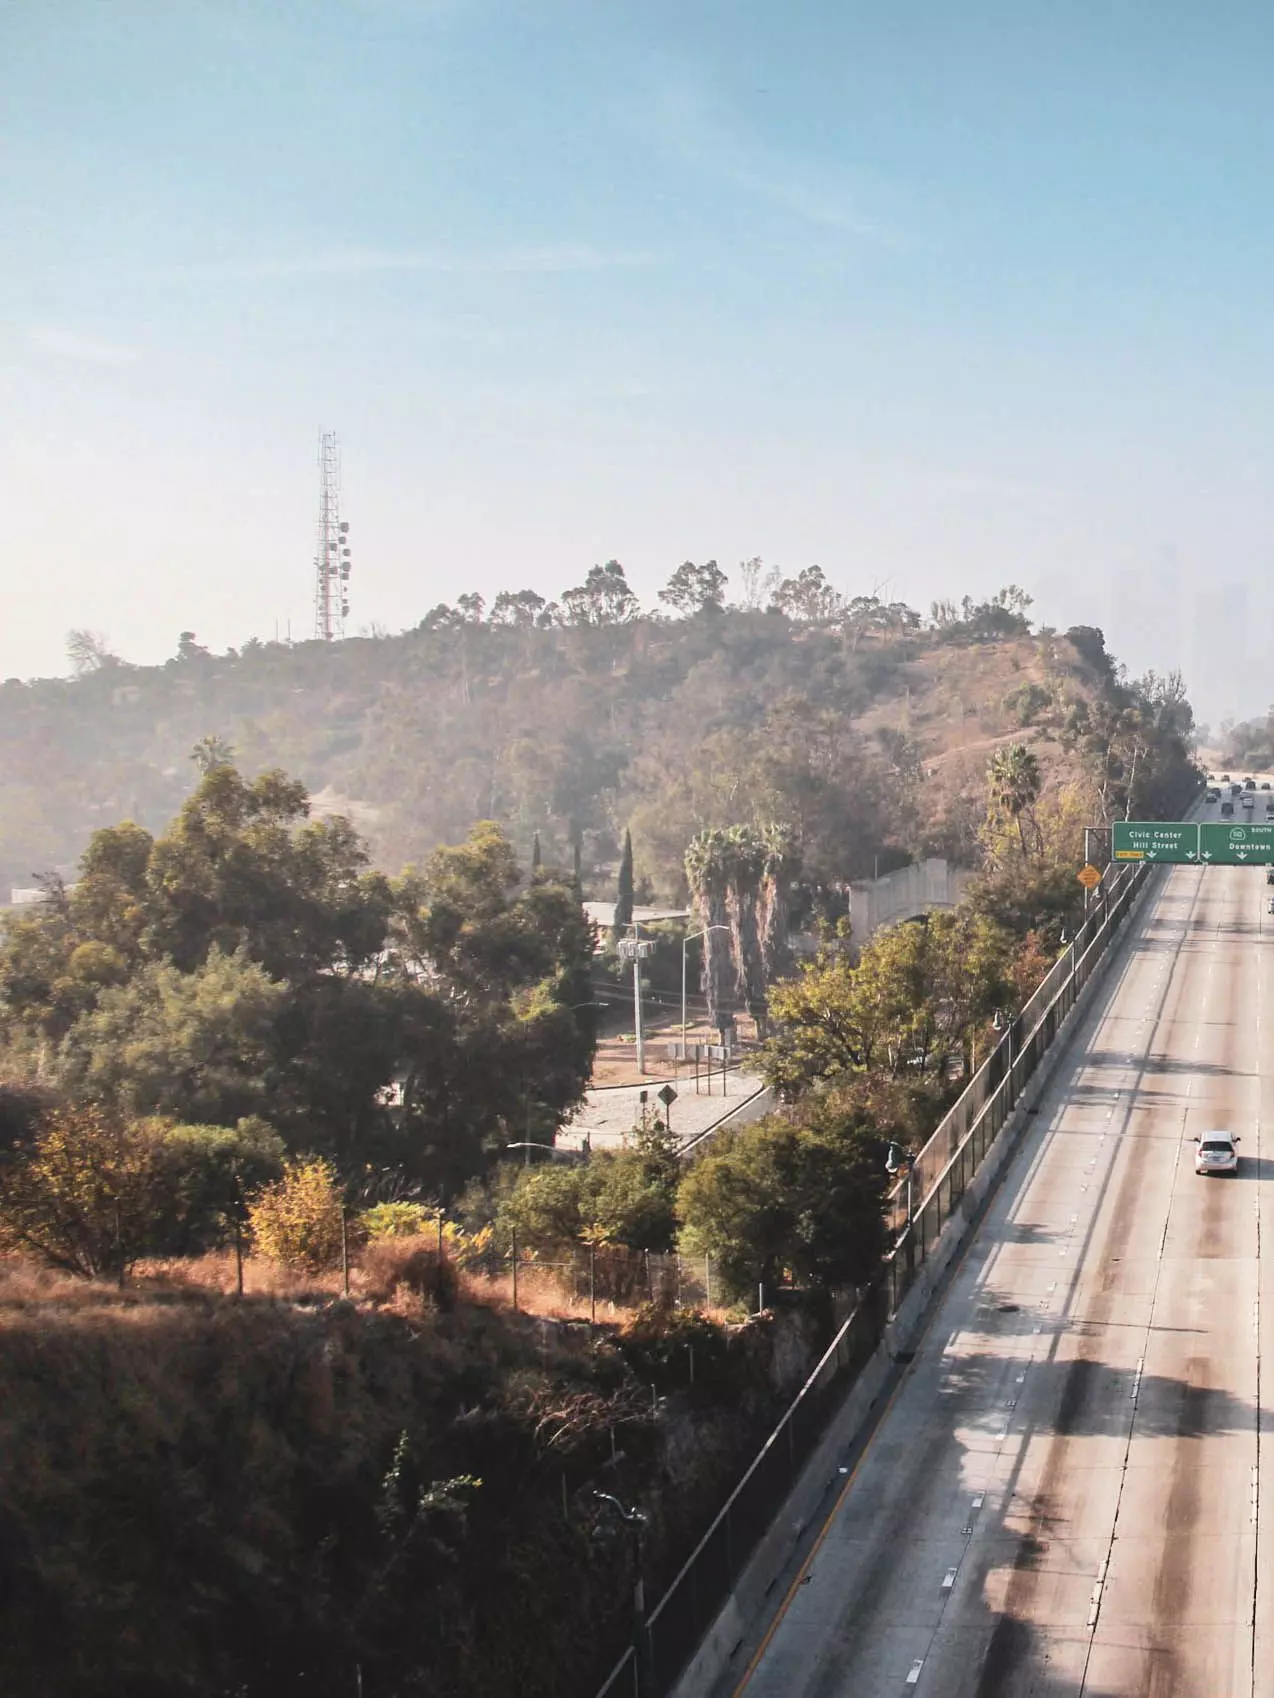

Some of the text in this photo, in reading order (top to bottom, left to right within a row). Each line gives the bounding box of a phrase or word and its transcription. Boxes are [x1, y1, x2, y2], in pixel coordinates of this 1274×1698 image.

[1154, 831, 1182, 839] Center
[1133, 841, 1178, 849] Hill Street
